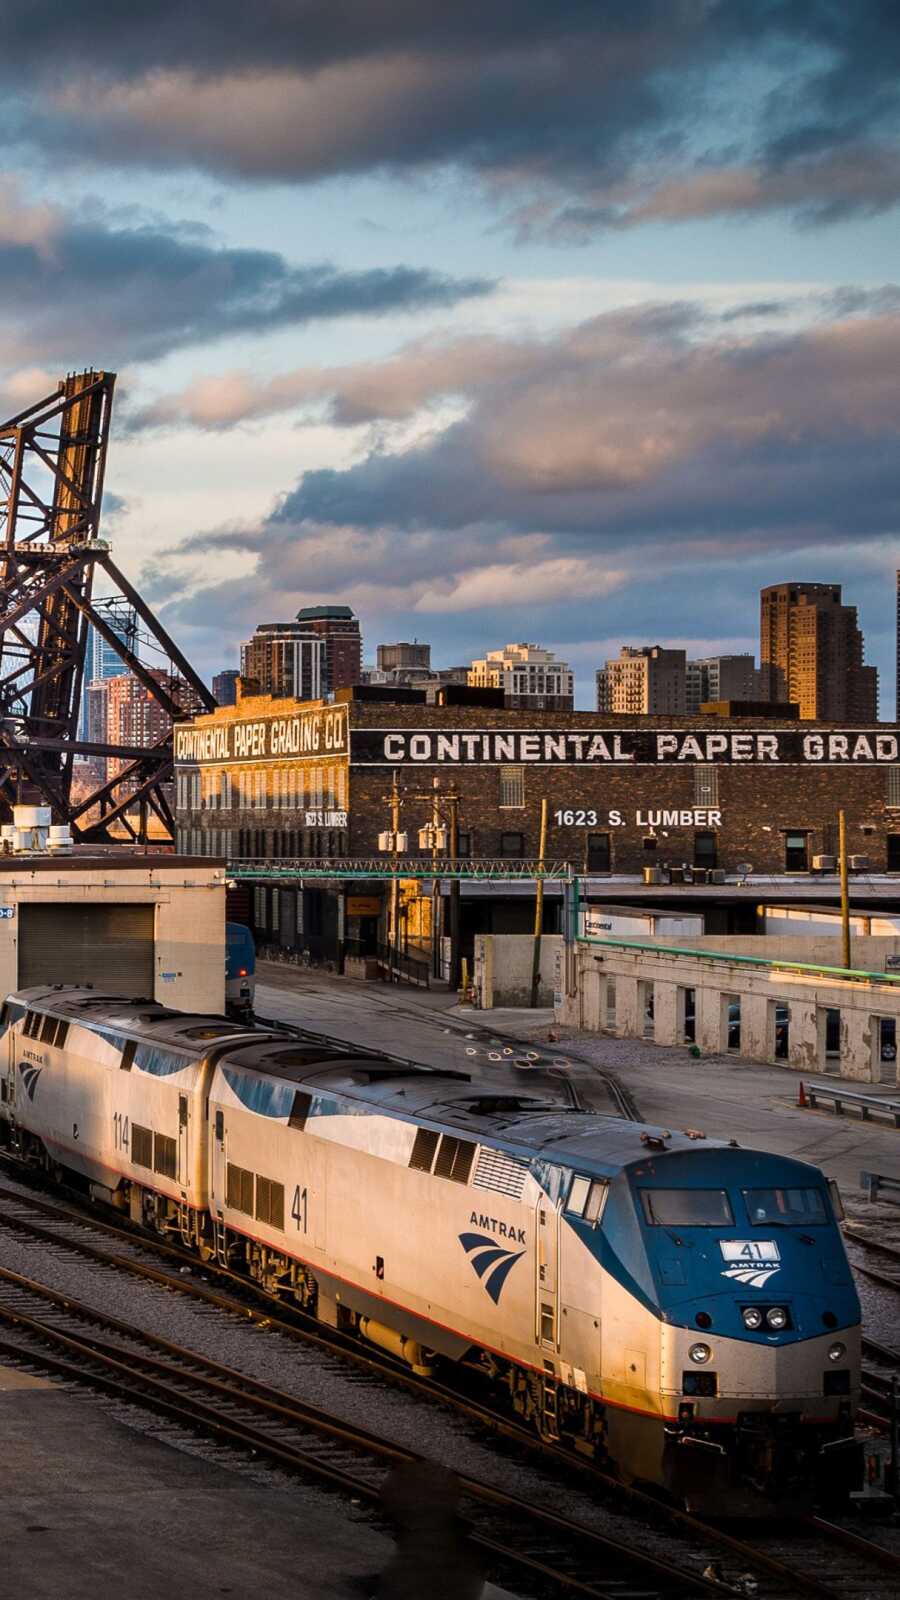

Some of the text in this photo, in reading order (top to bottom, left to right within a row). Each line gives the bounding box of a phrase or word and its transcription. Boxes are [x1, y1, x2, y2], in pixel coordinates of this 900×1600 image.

[177, 713, 344, 760] CONTINENTAL PAPER GRADING CO.
[384, 734, 898, 761] CONTINENTAL PAPER GRAD
[324, 811, 347, 826] LUMBER
[554, 810, 722, 826] 1623 S. LUMBER
[22, 1049, 43, 1064] AMTRAK
[113, 1111, 129, 1153] 114
[291, 1184, 308, 1234] 41
[470, 1211, 526, 1245] AMTRAK
[741, 1243, 762, 1259] 41
